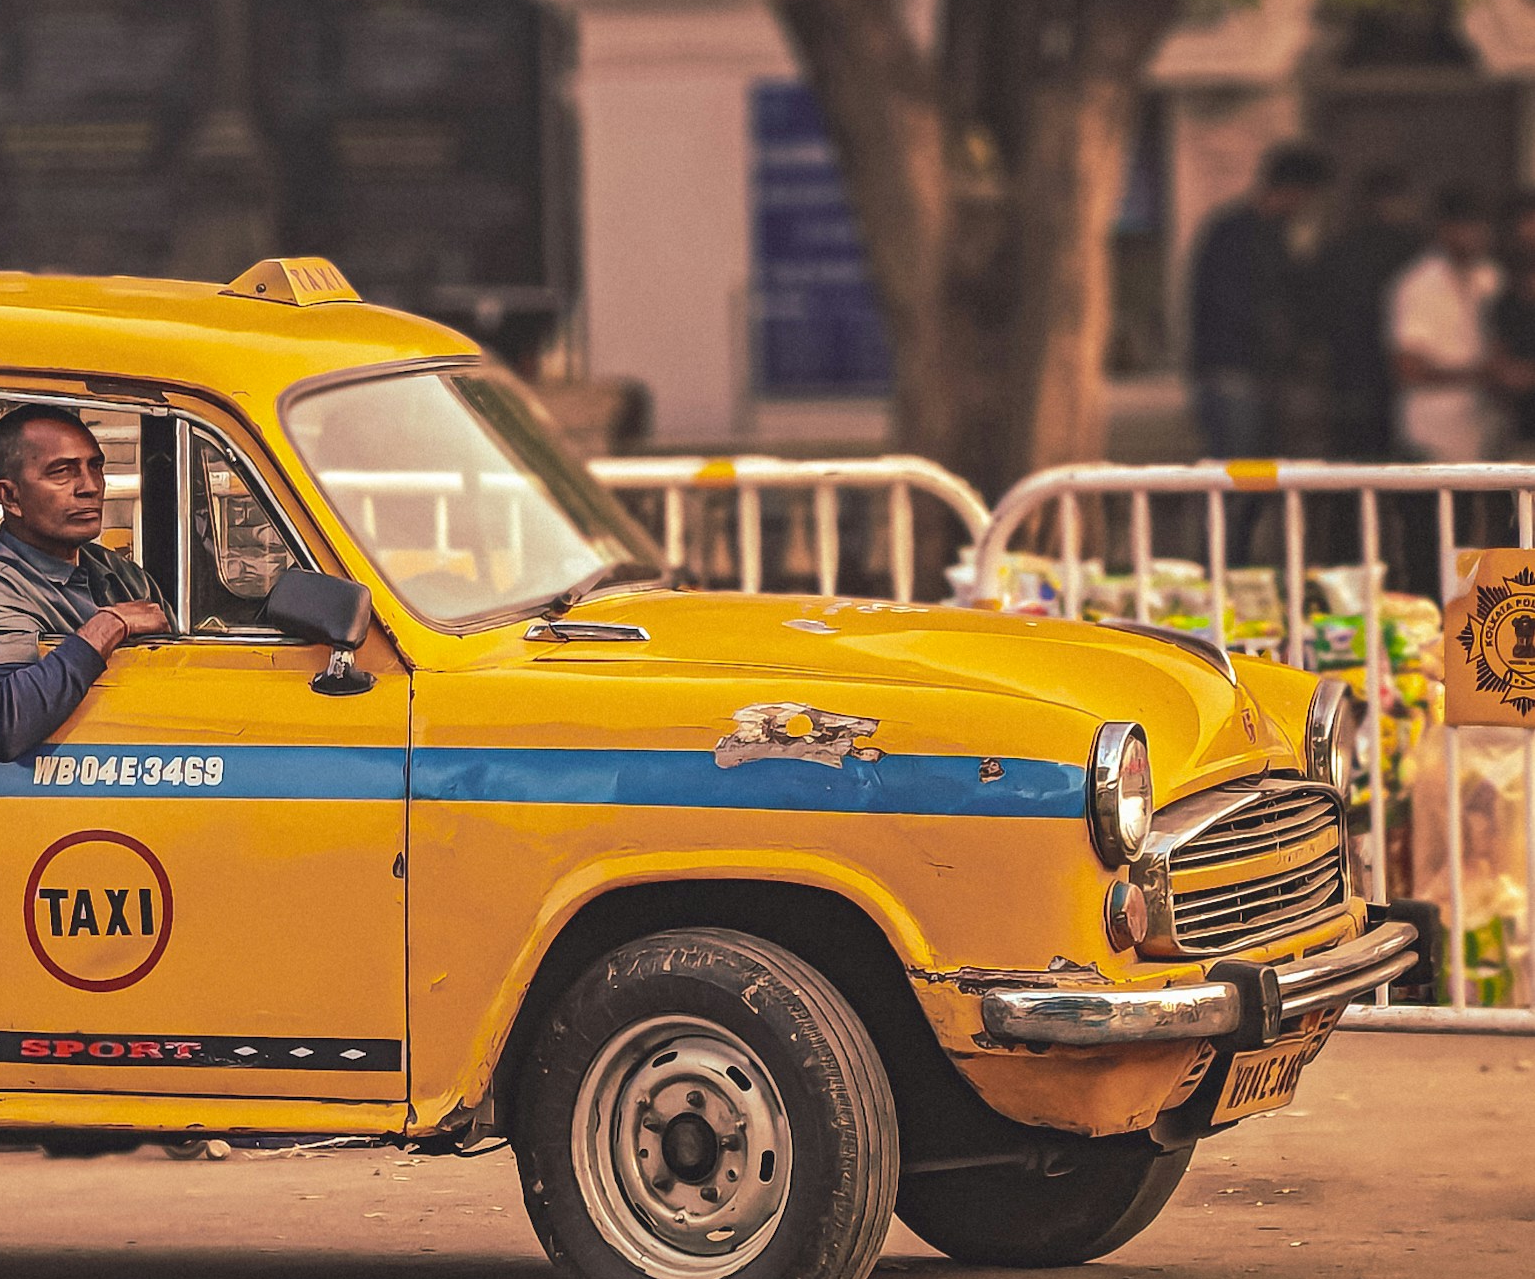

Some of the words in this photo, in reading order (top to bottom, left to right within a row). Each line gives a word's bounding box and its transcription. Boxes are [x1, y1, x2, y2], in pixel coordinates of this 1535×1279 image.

[289, 266, 344, 292] TAXI
[38, 888, 155, 937] TAXI
[20, 1038, 202, 1060] SPORT
